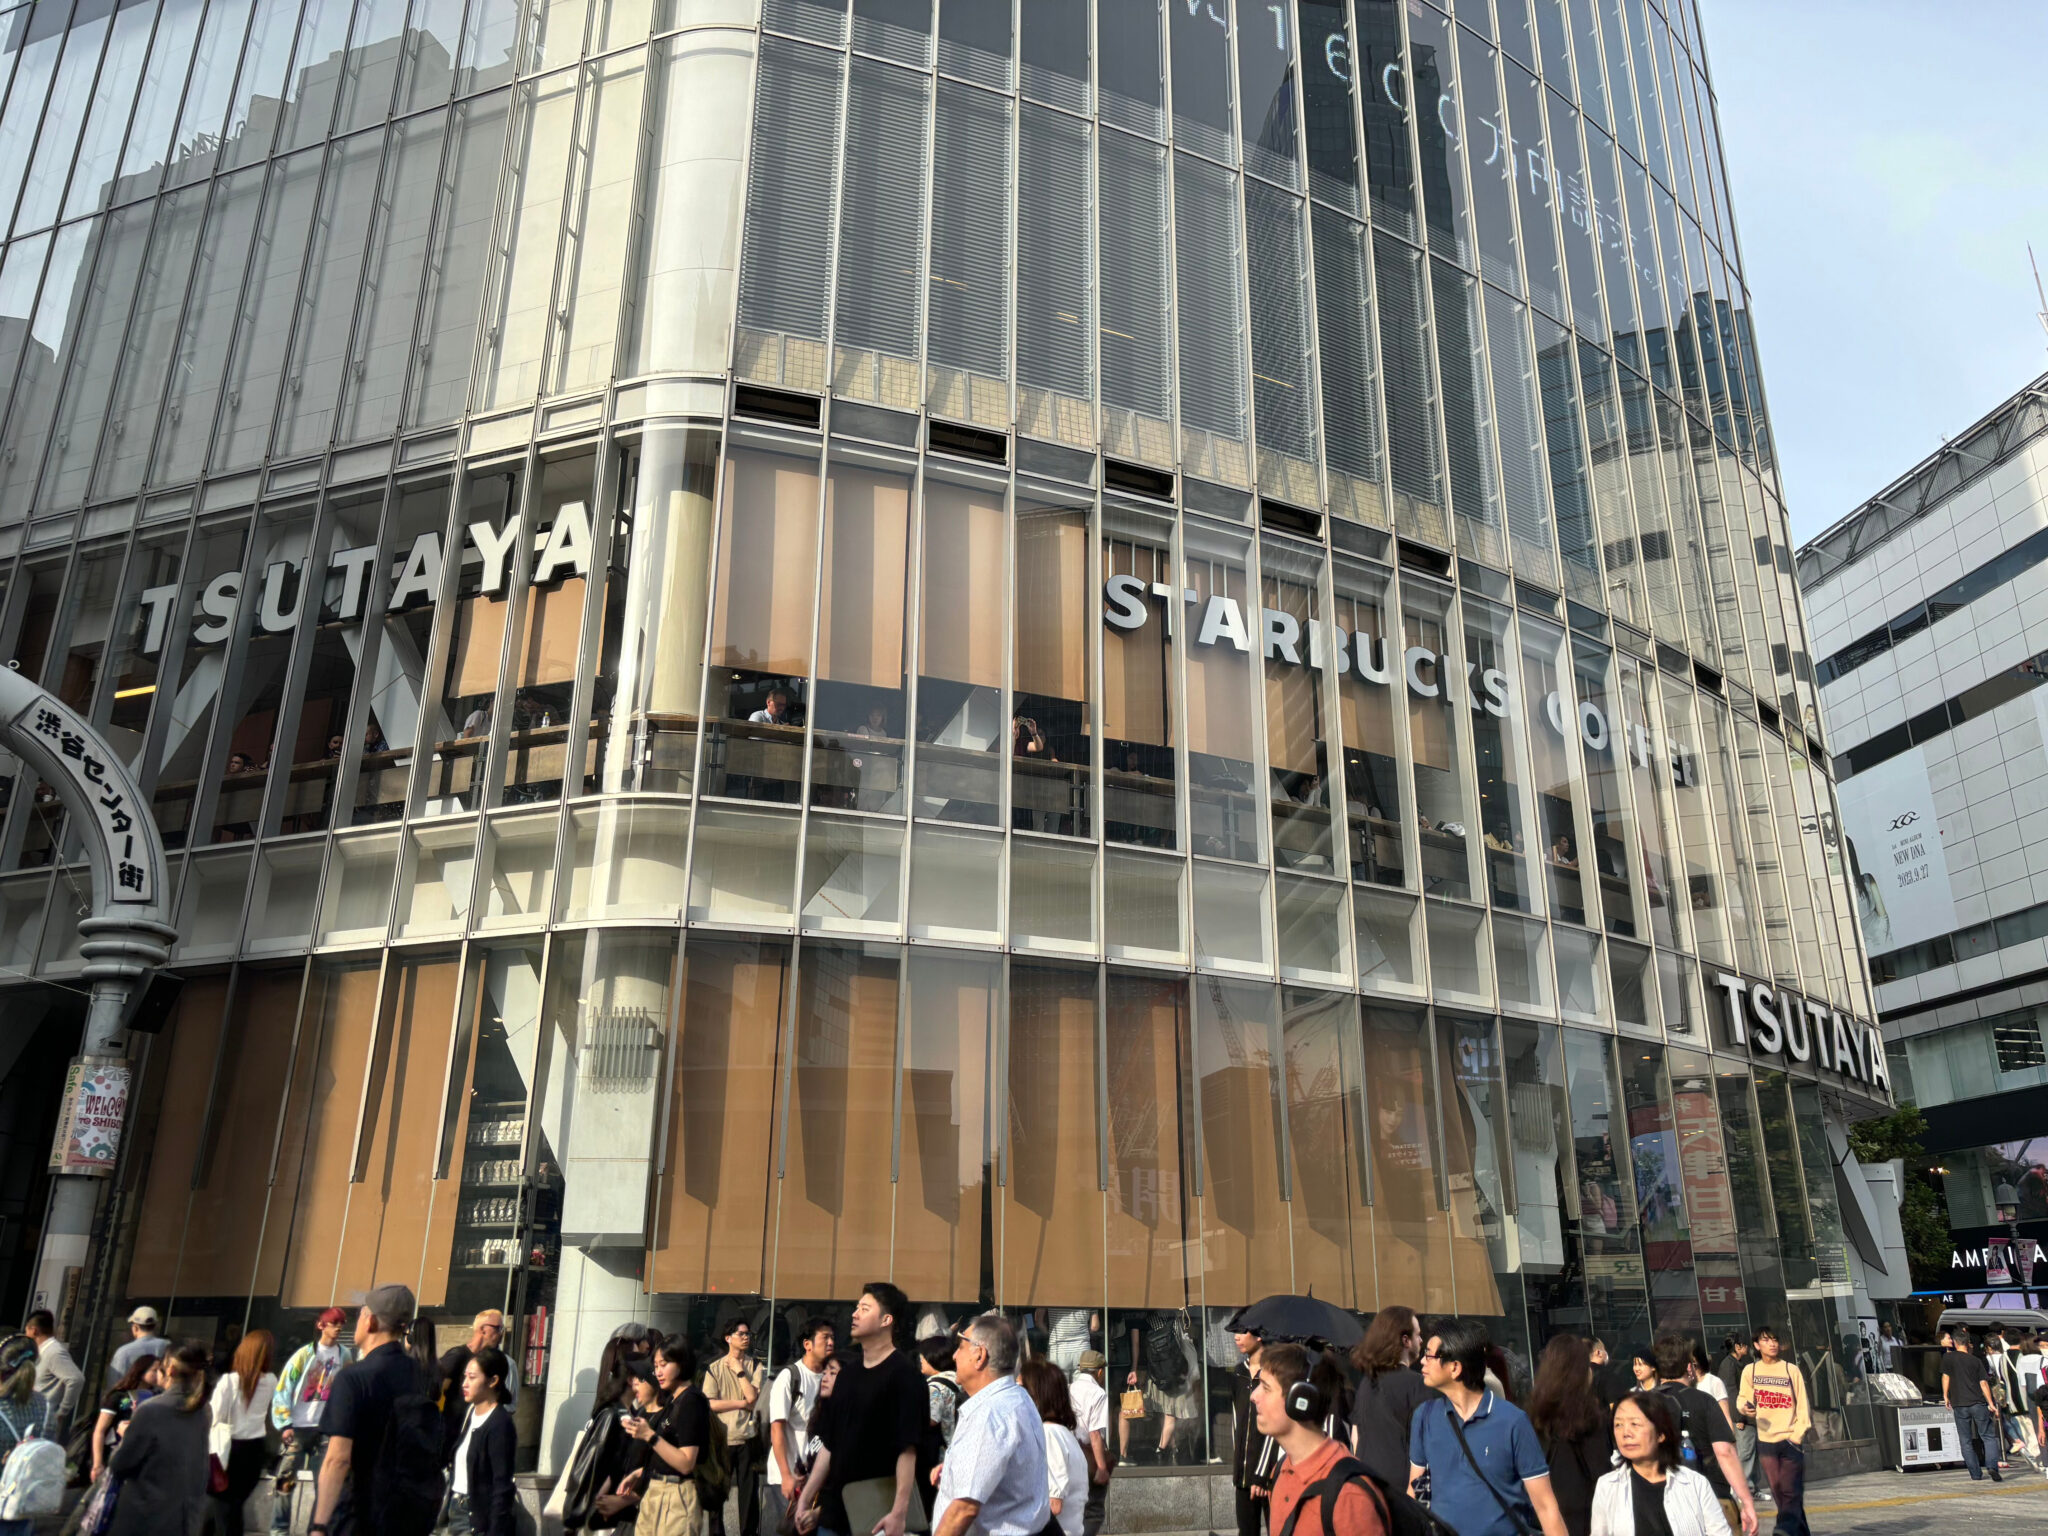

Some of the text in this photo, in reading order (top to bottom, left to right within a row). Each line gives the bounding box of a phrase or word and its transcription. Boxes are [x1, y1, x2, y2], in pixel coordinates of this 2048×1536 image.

[139, 500, 595, 655] TSUTAYA
[1104, 573, 1513, 719] STARBUCKS
[35, 708, 145, 893] 渋谷センター街
[1893, 843, 1926, 867] NEW DNA
[1715, 970, 1890, 1092] TSUTAYA
